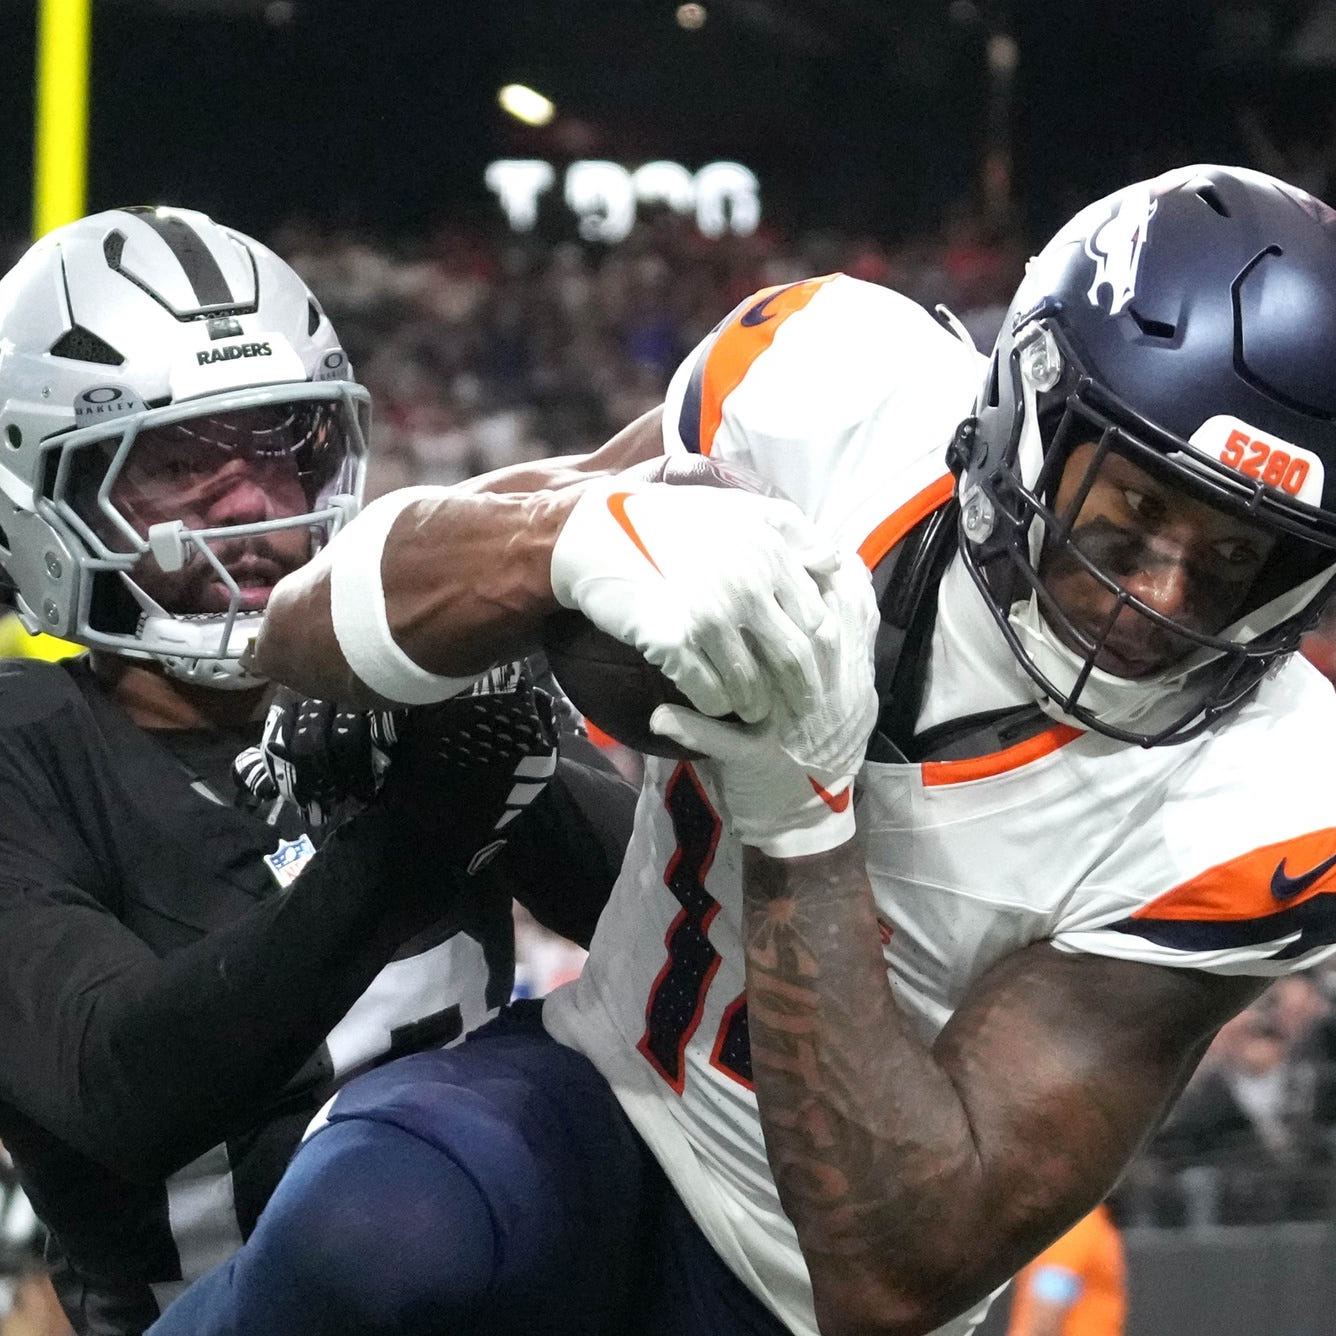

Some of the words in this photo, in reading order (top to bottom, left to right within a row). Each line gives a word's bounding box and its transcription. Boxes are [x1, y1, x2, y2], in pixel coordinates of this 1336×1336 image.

[196, 342, 273, 366] RAIDERS
[75, 401, 134, 415] OAKLEY
[1220, 429, 1311, 497] 5280
[635, 757, 756, 1098] 1
